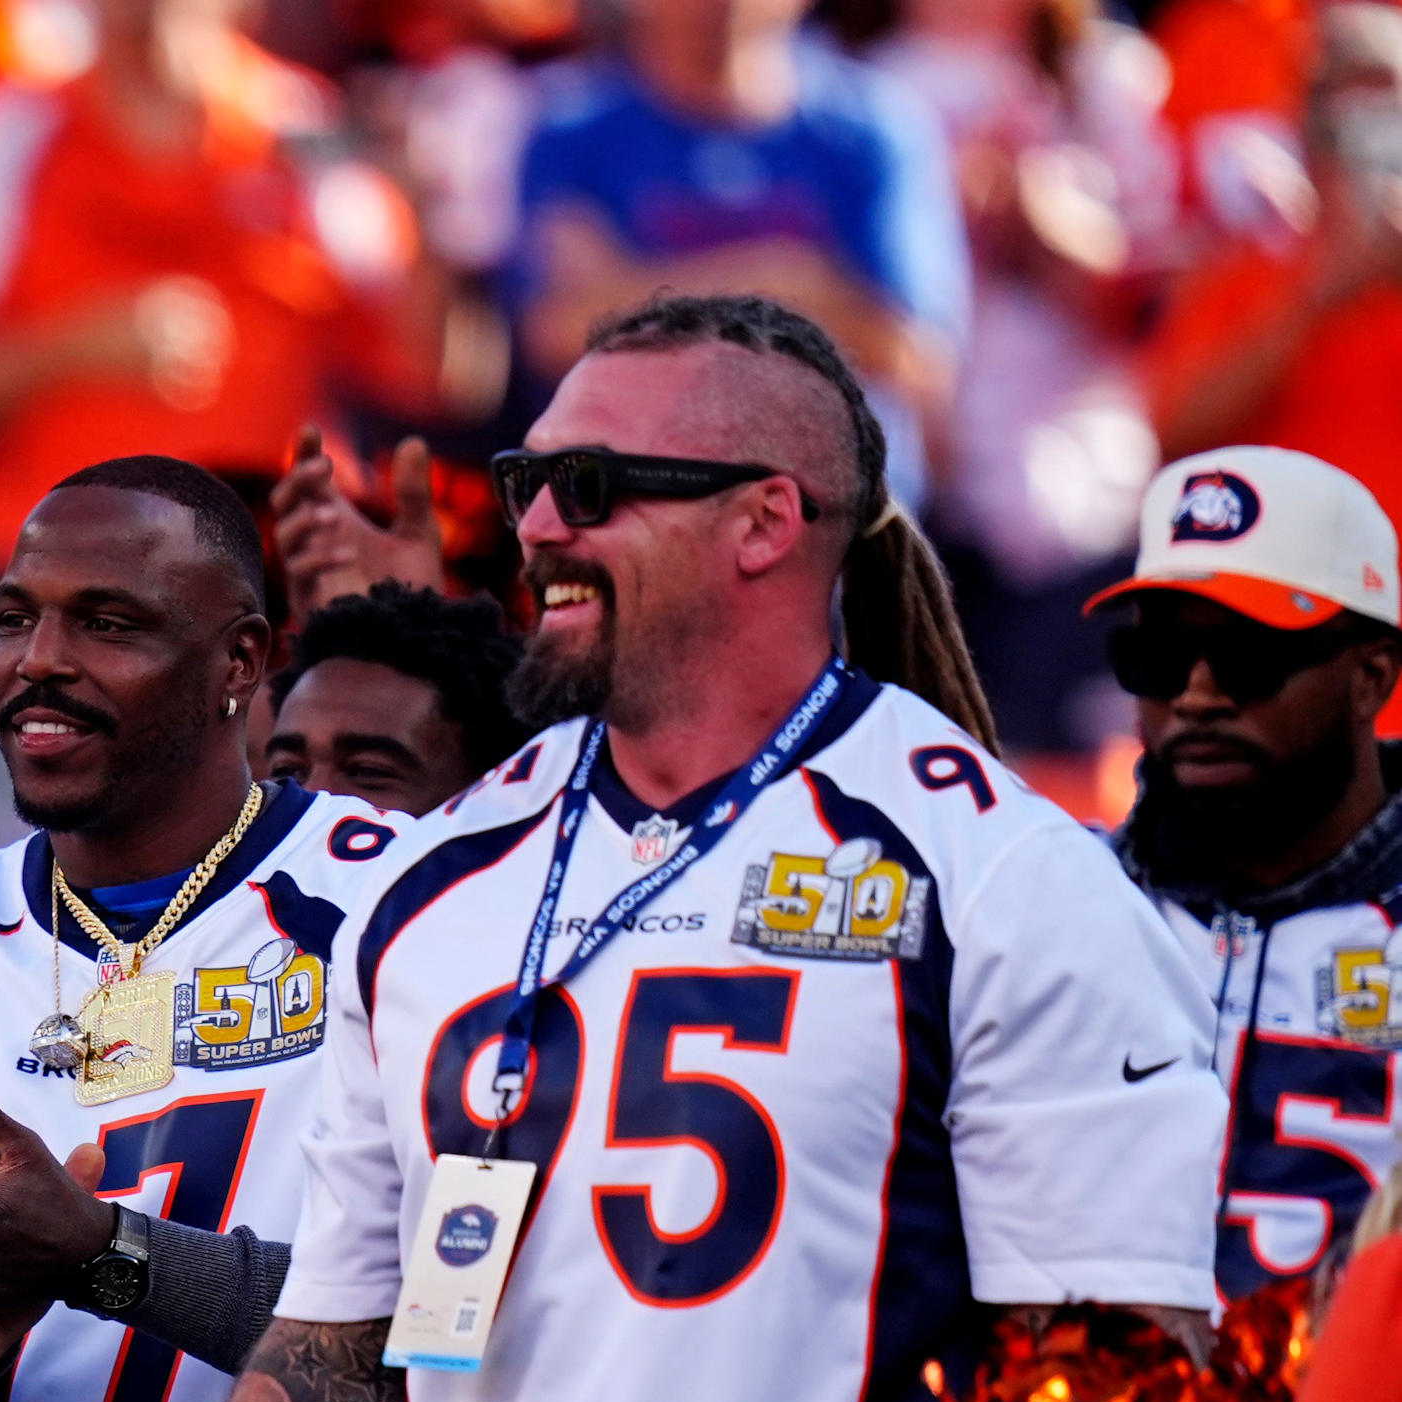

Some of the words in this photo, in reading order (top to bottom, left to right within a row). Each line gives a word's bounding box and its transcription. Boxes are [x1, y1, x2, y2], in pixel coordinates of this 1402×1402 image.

[605, 844, 699, 925] BRONCOS
[760, 852, 909, 937] 50
[191, 953, 325, 1046] 50
[197, 1041, 267, 1060] SUPER
[271, 1027, 322, 1051] BOWL
[421, 966, 802, 1310] 95
[441, 1235, 488, 1250] ALUMNI
